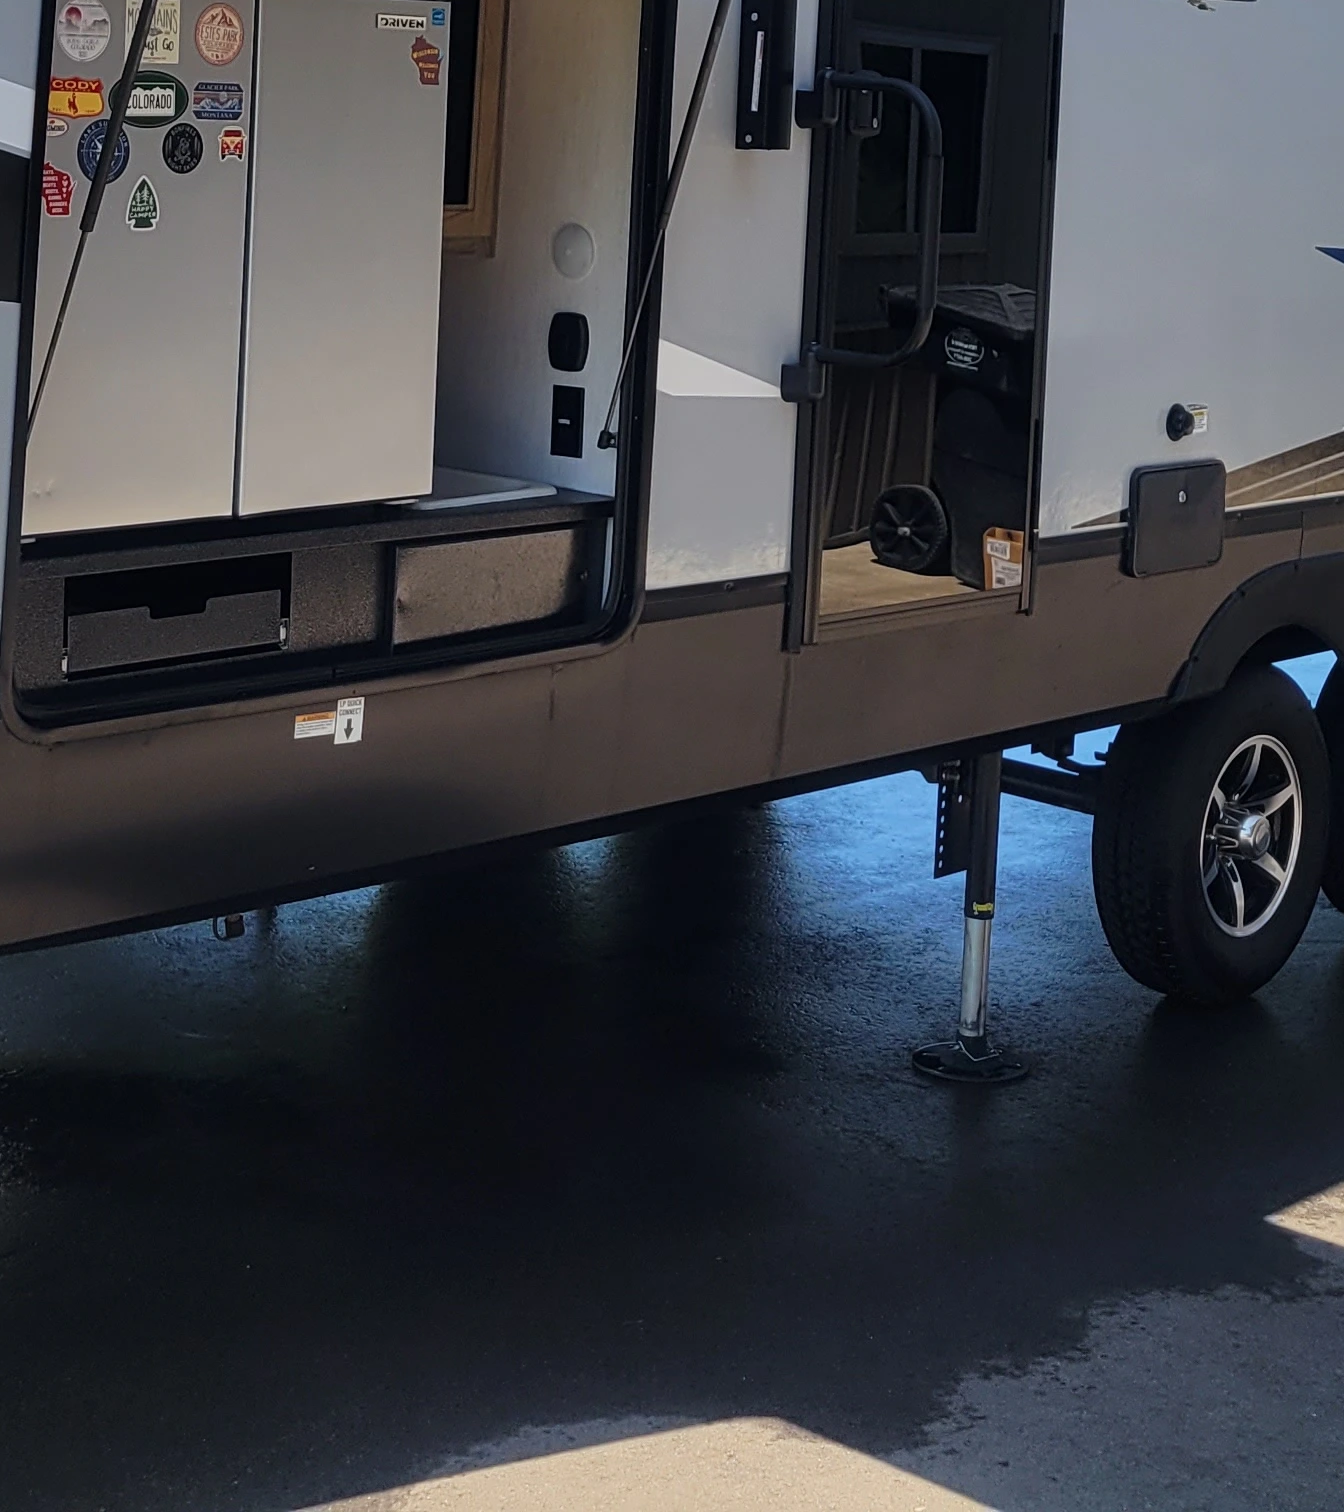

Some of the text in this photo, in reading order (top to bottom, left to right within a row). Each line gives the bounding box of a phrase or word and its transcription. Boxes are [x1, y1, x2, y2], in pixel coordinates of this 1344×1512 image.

[127, 7, 178, 34] MAINS
[380, 17, 425, 29] DRIVEN
[200, 24, 239, 43] ESTES PARK
[51, 79, 99, 90] CODY
[201, 111, 233, 119] MONTANA
[80, 124, 96, 144] LAKE
[131, 205, 154, 213] HAPPY
[129, 211, 156, 219] CAMPER
[339, 700, 347, 708] LP
[339, 708, 362, 716] CONNECT
